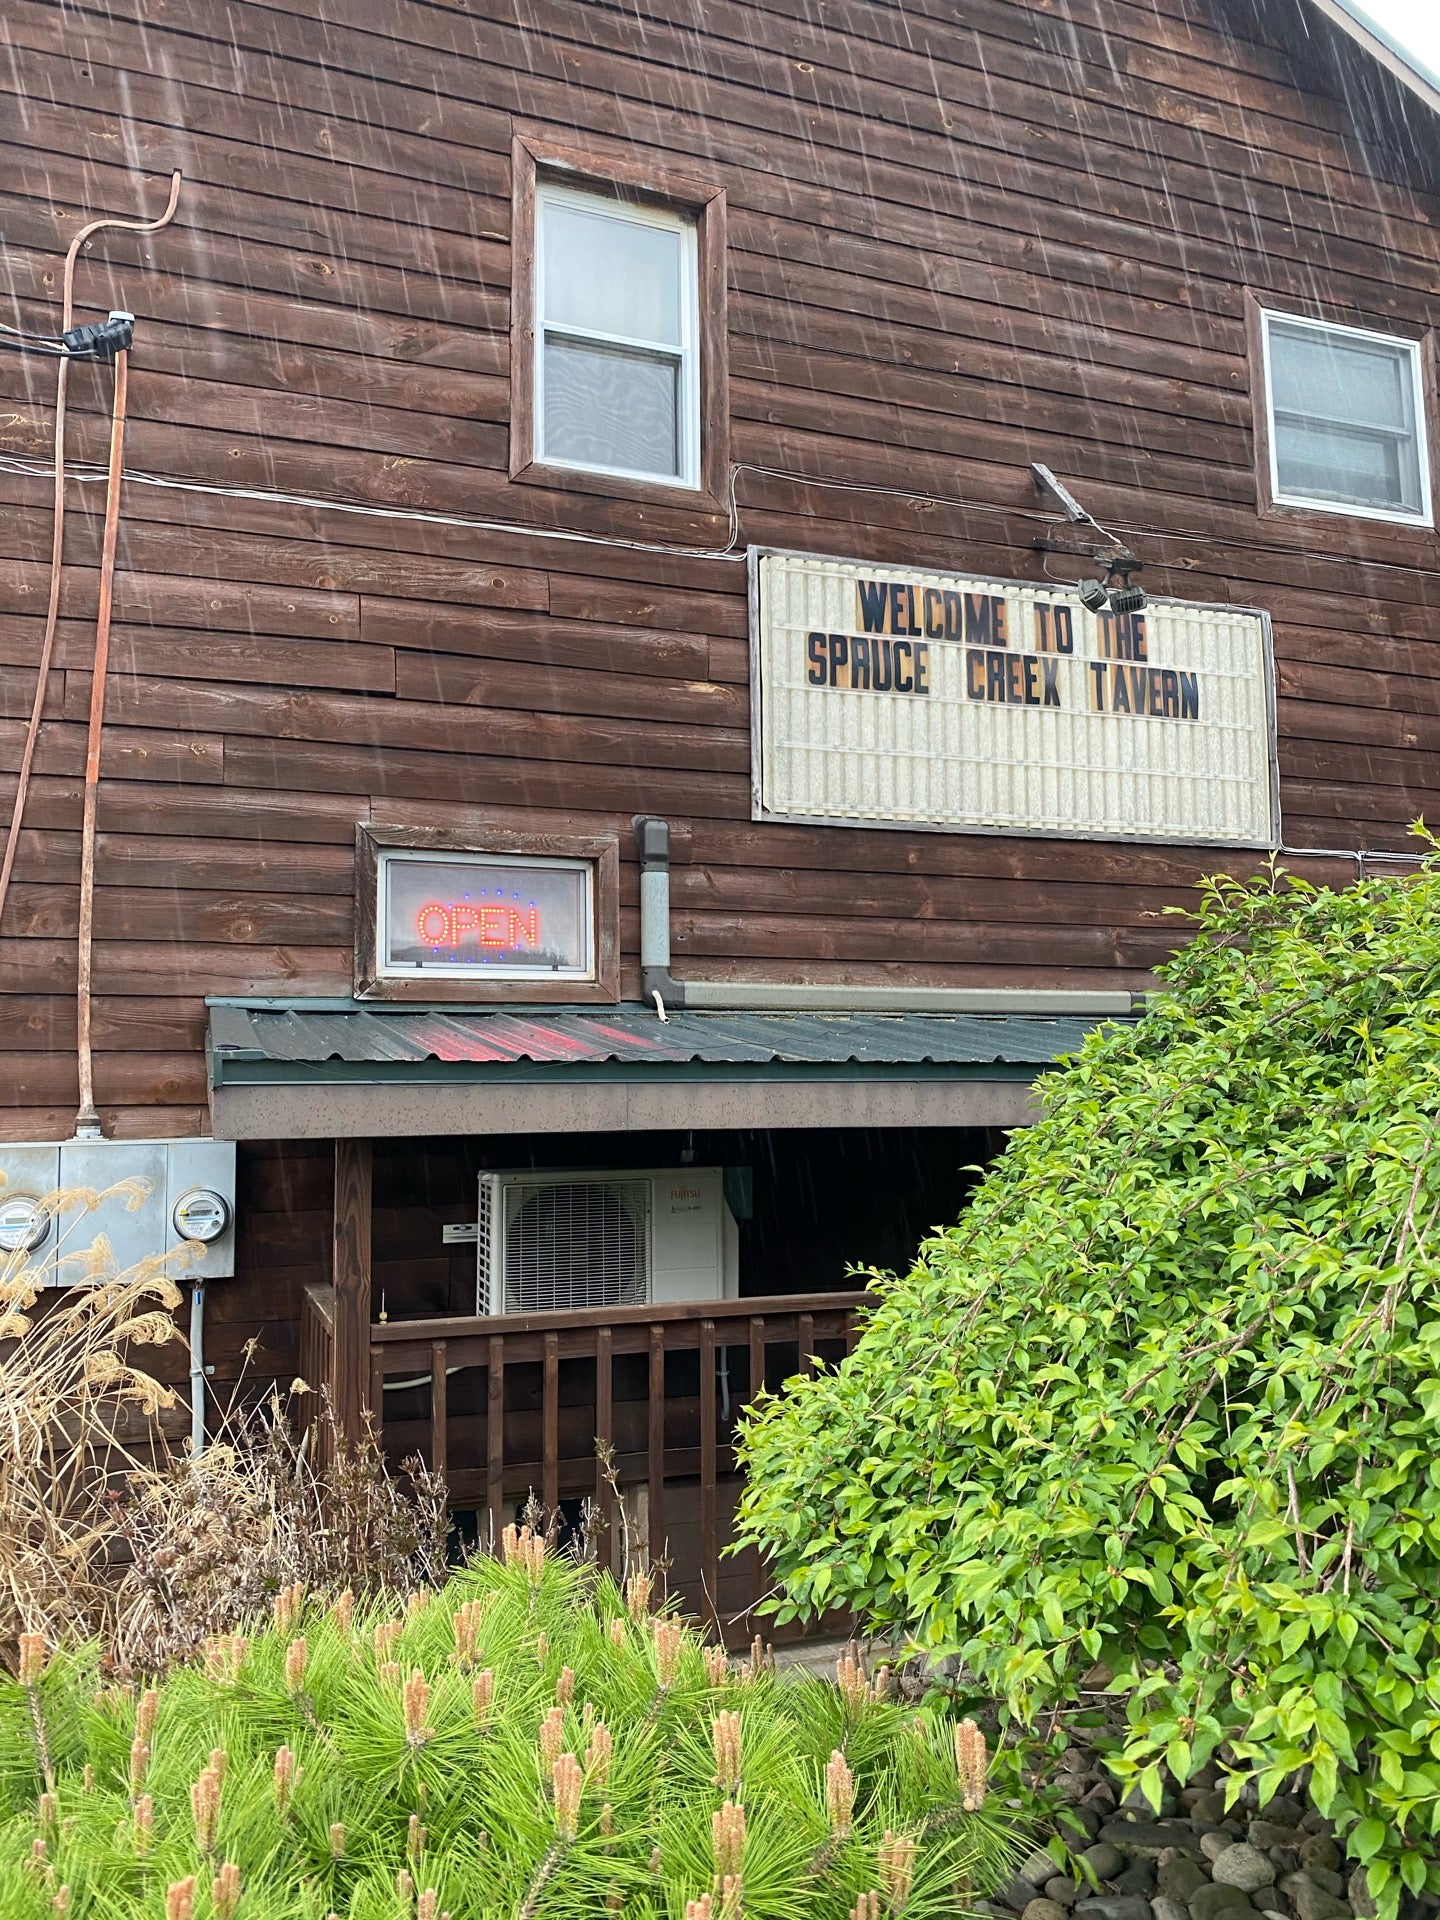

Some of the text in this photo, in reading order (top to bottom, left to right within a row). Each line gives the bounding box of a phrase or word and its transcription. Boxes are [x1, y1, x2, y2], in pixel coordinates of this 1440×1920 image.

[858, 580, 1147, 662] WELCOME TO THE
[808, 632, 1198, 720] SPRUCE CREEK TAVERN
[418, 904, 538, 947] OPEN
[670, 1186, 700, 1200] FUJITSU
